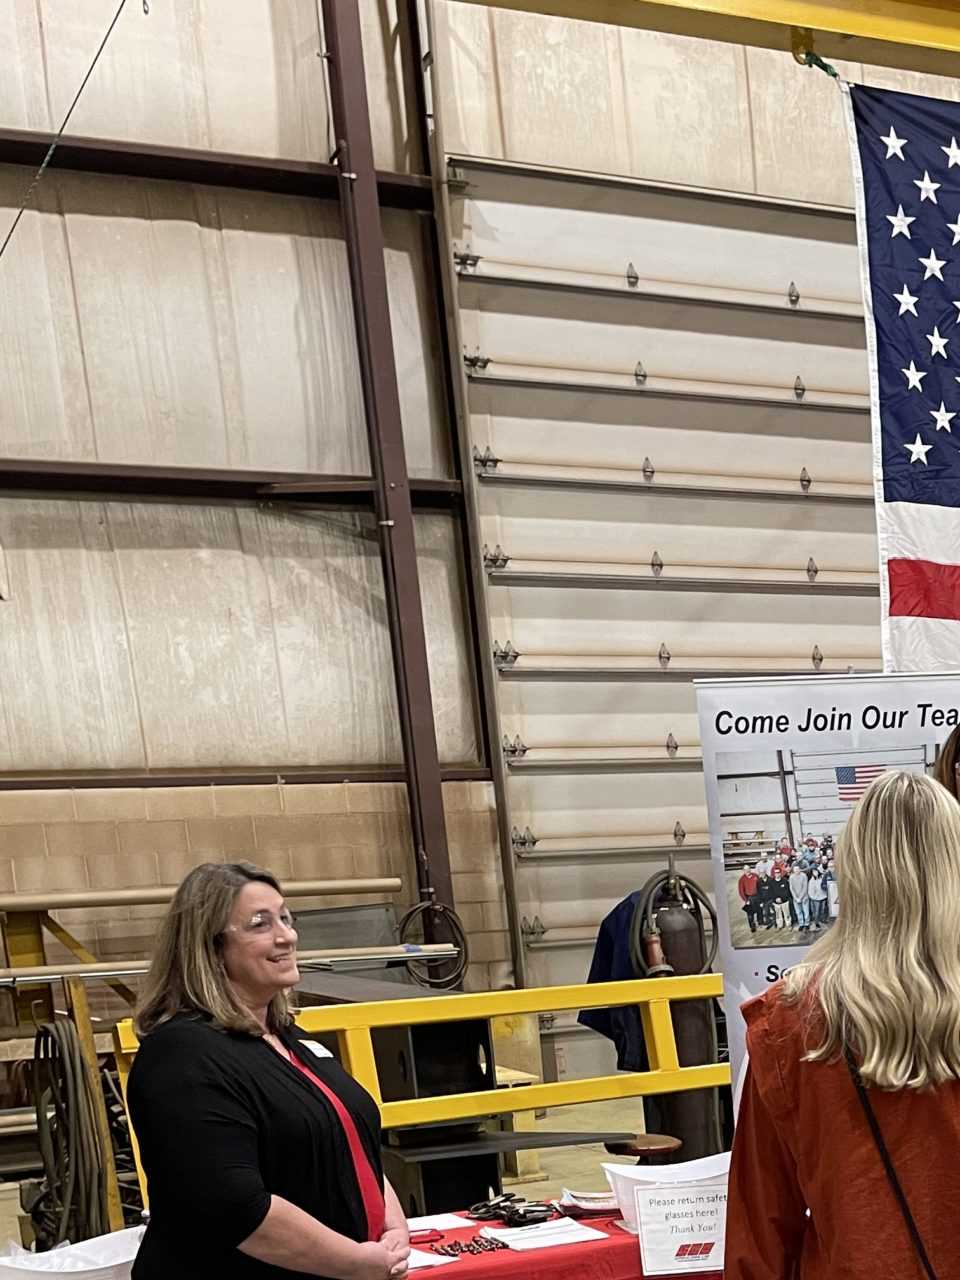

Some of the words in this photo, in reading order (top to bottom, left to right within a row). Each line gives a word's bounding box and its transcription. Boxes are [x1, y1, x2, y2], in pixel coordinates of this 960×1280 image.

[715, 710, 790, 735] Come
[797, 706, 852, 732] Join
[861, 704, 909, 730] Our
[648, 1198, 676, 1207] Please
[677, 1194, 705, 1205] return
[706, 1193, 728, 1203] safet
[664, 1211, 694, 1221] glasses
[695, 1208, 719, 1218] here!
[670, 1224, 695, 1234] Thank
